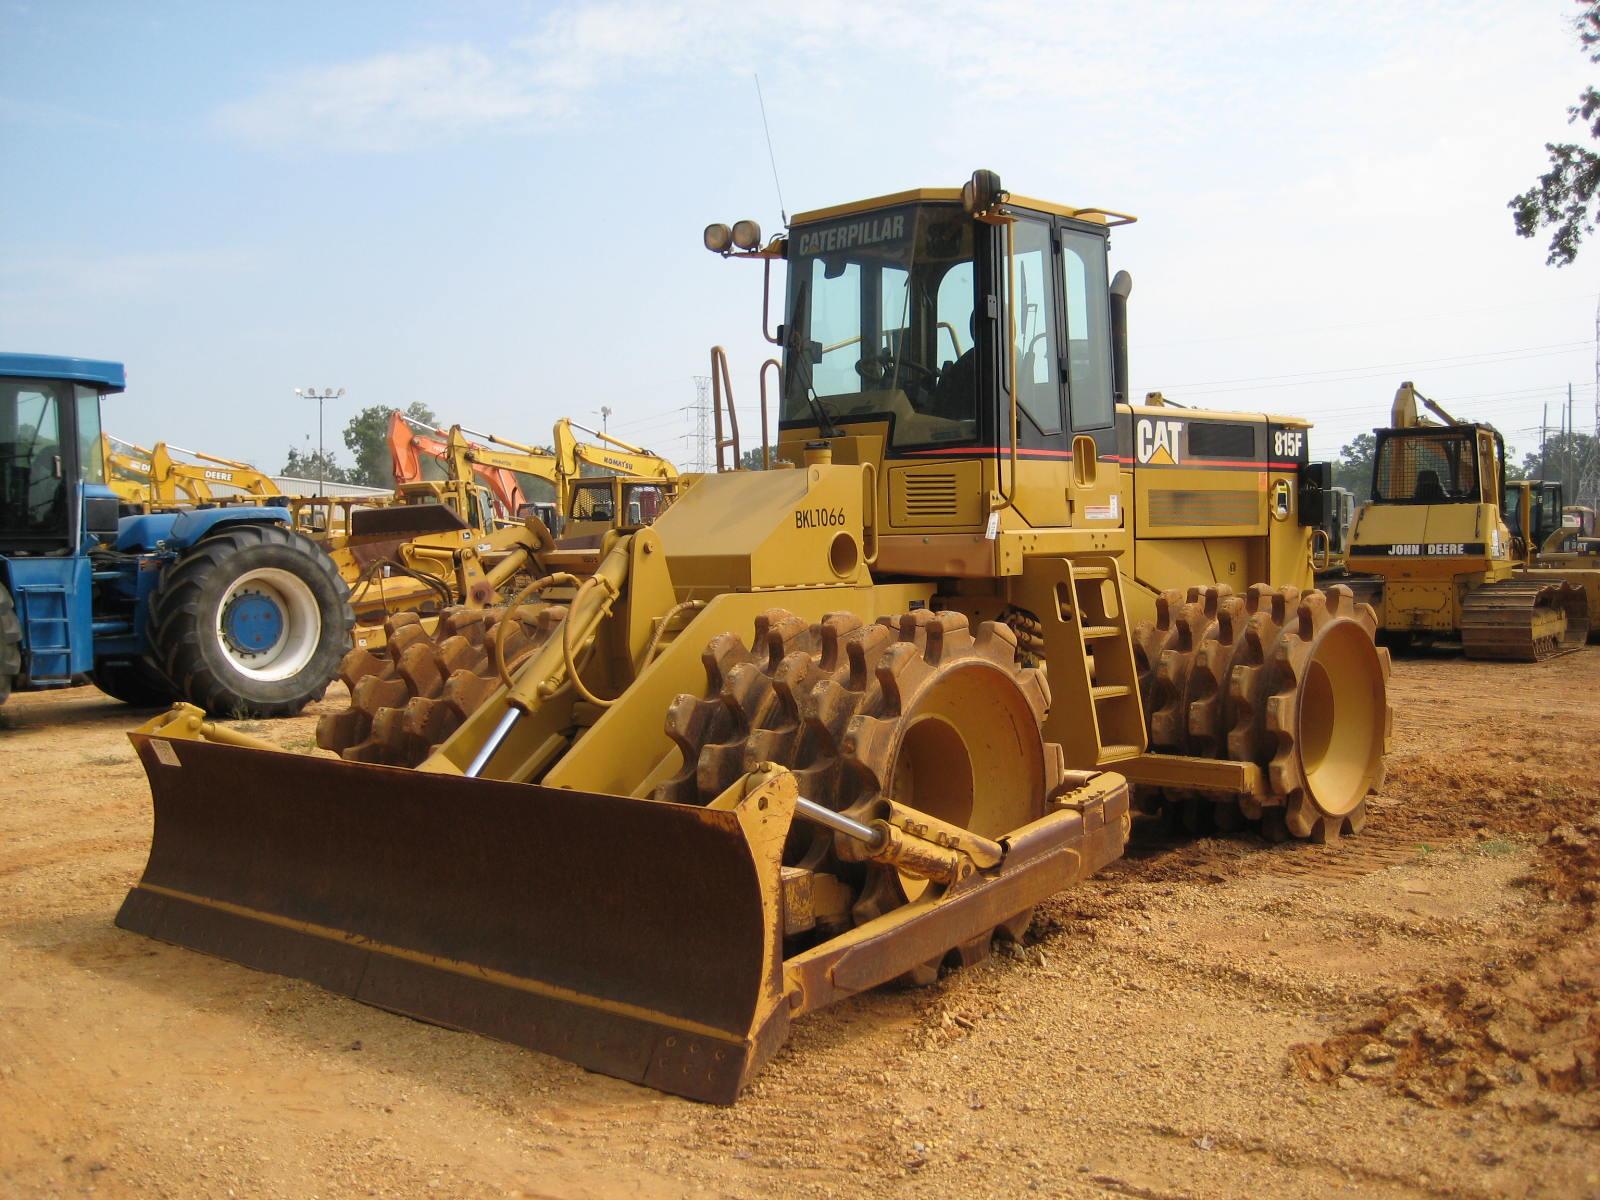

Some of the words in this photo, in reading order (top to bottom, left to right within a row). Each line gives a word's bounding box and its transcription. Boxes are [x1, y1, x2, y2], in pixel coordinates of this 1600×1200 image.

[800, 215, 904, 256] CATERPILLAR
[1137, 419, 1183, 464] CAT
[1274, 431, 1302, 457] 815F
[603, 456, 633, 470] KOMATSU
[205, 470, 232, 481] DEERE
[795, 507, 846, 528] BKL1066
[1388, 544, 1420, 555] JOHN
[1427, 543, 1464, 555] DEERE
